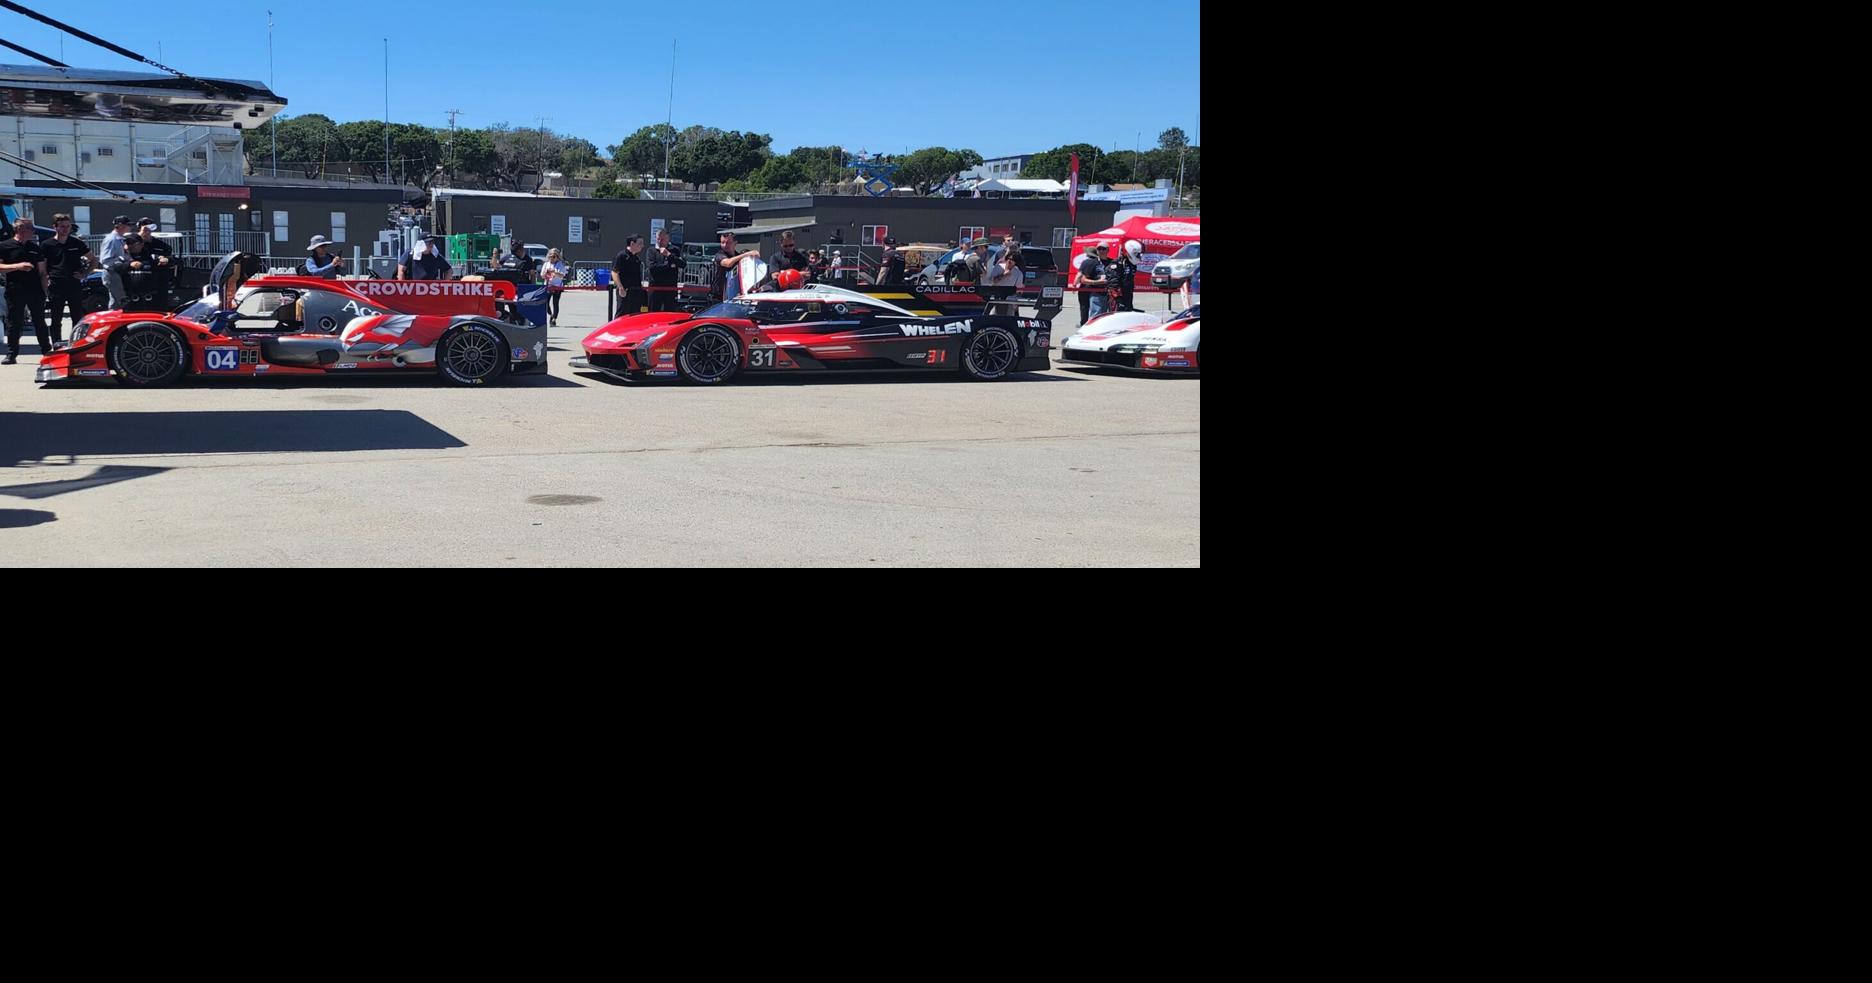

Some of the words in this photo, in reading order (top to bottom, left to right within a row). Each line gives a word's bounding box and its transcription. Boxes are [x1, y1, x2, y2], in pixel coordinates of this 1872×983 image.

[355, 282, 494, 297] CROWDSTRIKE
[899, 319, 972, 337] WHELEN
[1017, 319, 1040, 328] Mobil
[207, 350, 237, 369] 04
[751, 350, 774, 367] 31
[927, 349, 946, 364] 31
